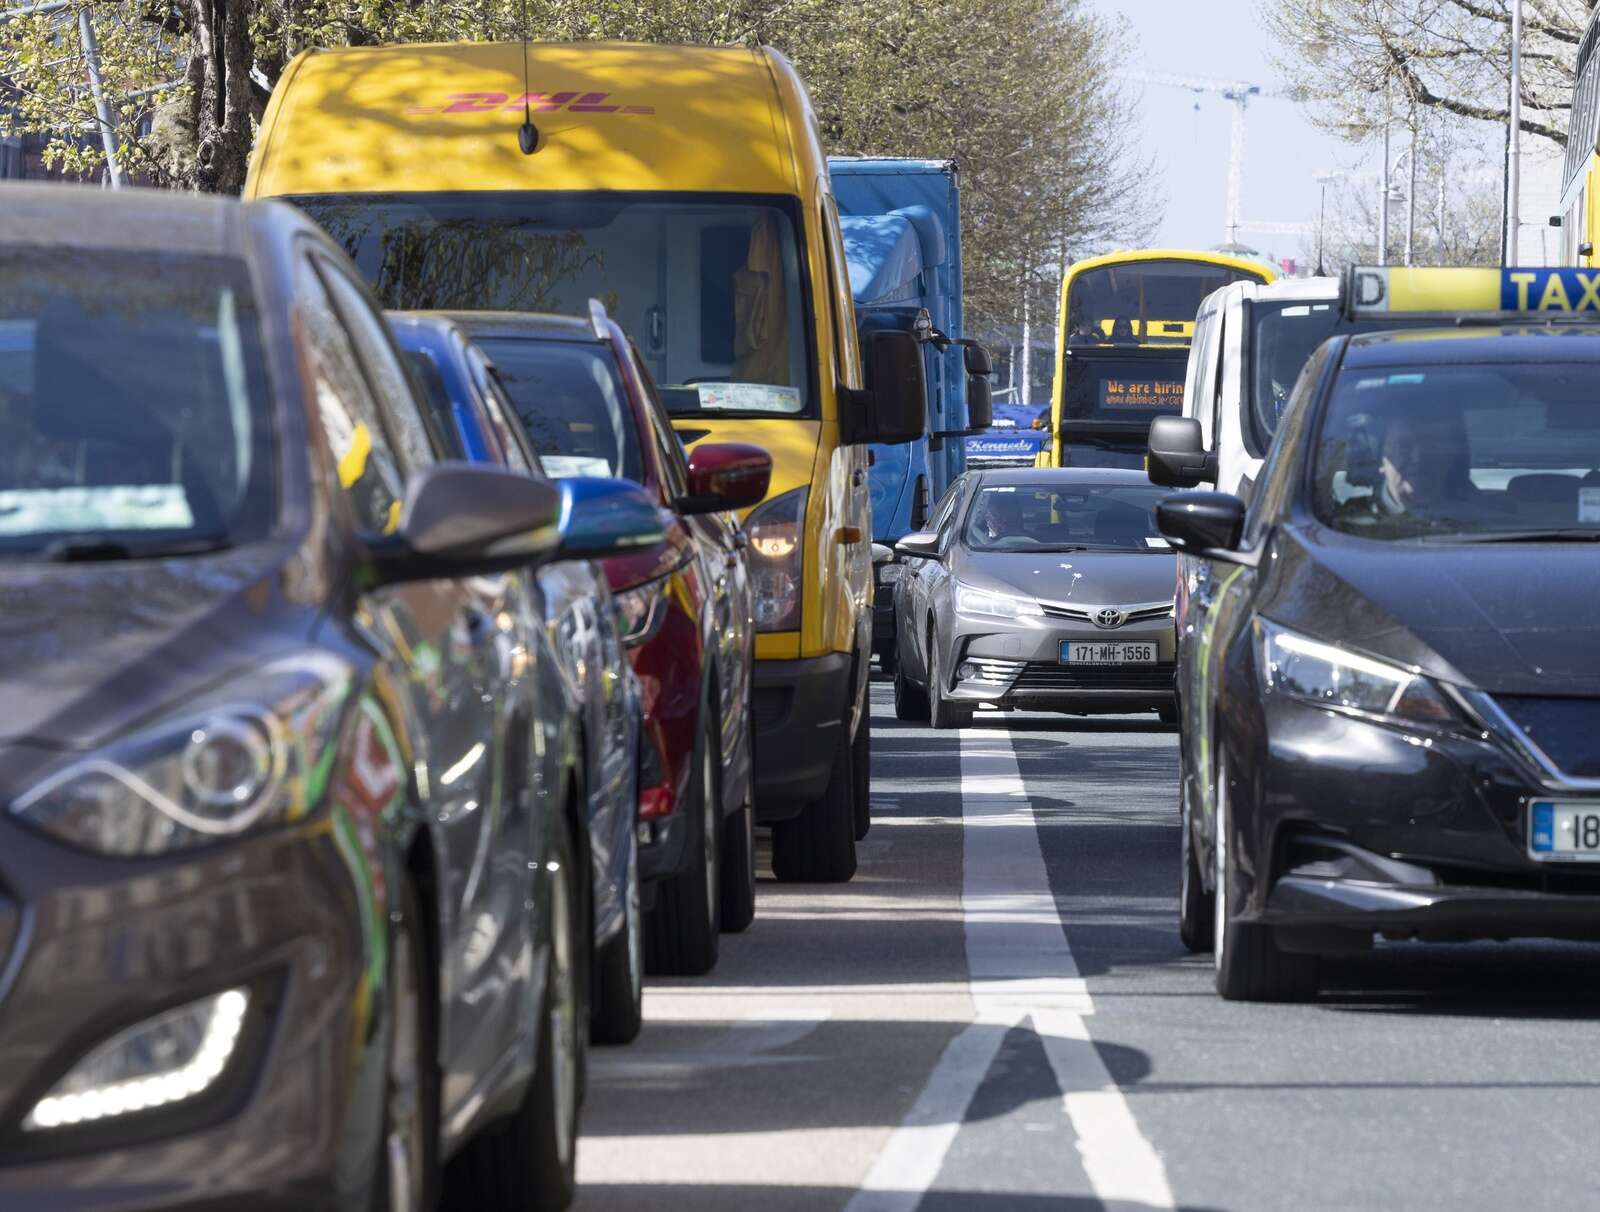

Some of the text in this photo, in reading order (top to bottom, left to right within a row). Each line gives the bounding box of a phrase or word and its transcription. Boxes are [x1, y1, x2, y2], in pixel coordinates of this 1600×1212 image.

[440, 92, 619, 113] DHL
[1107, 381, 1125, 393] We
[1129, 383, 1150, 393] are
[967, 440, 1033, 452] Kennedy
[1075, 646, 1151, 661] 171-MH-1556
